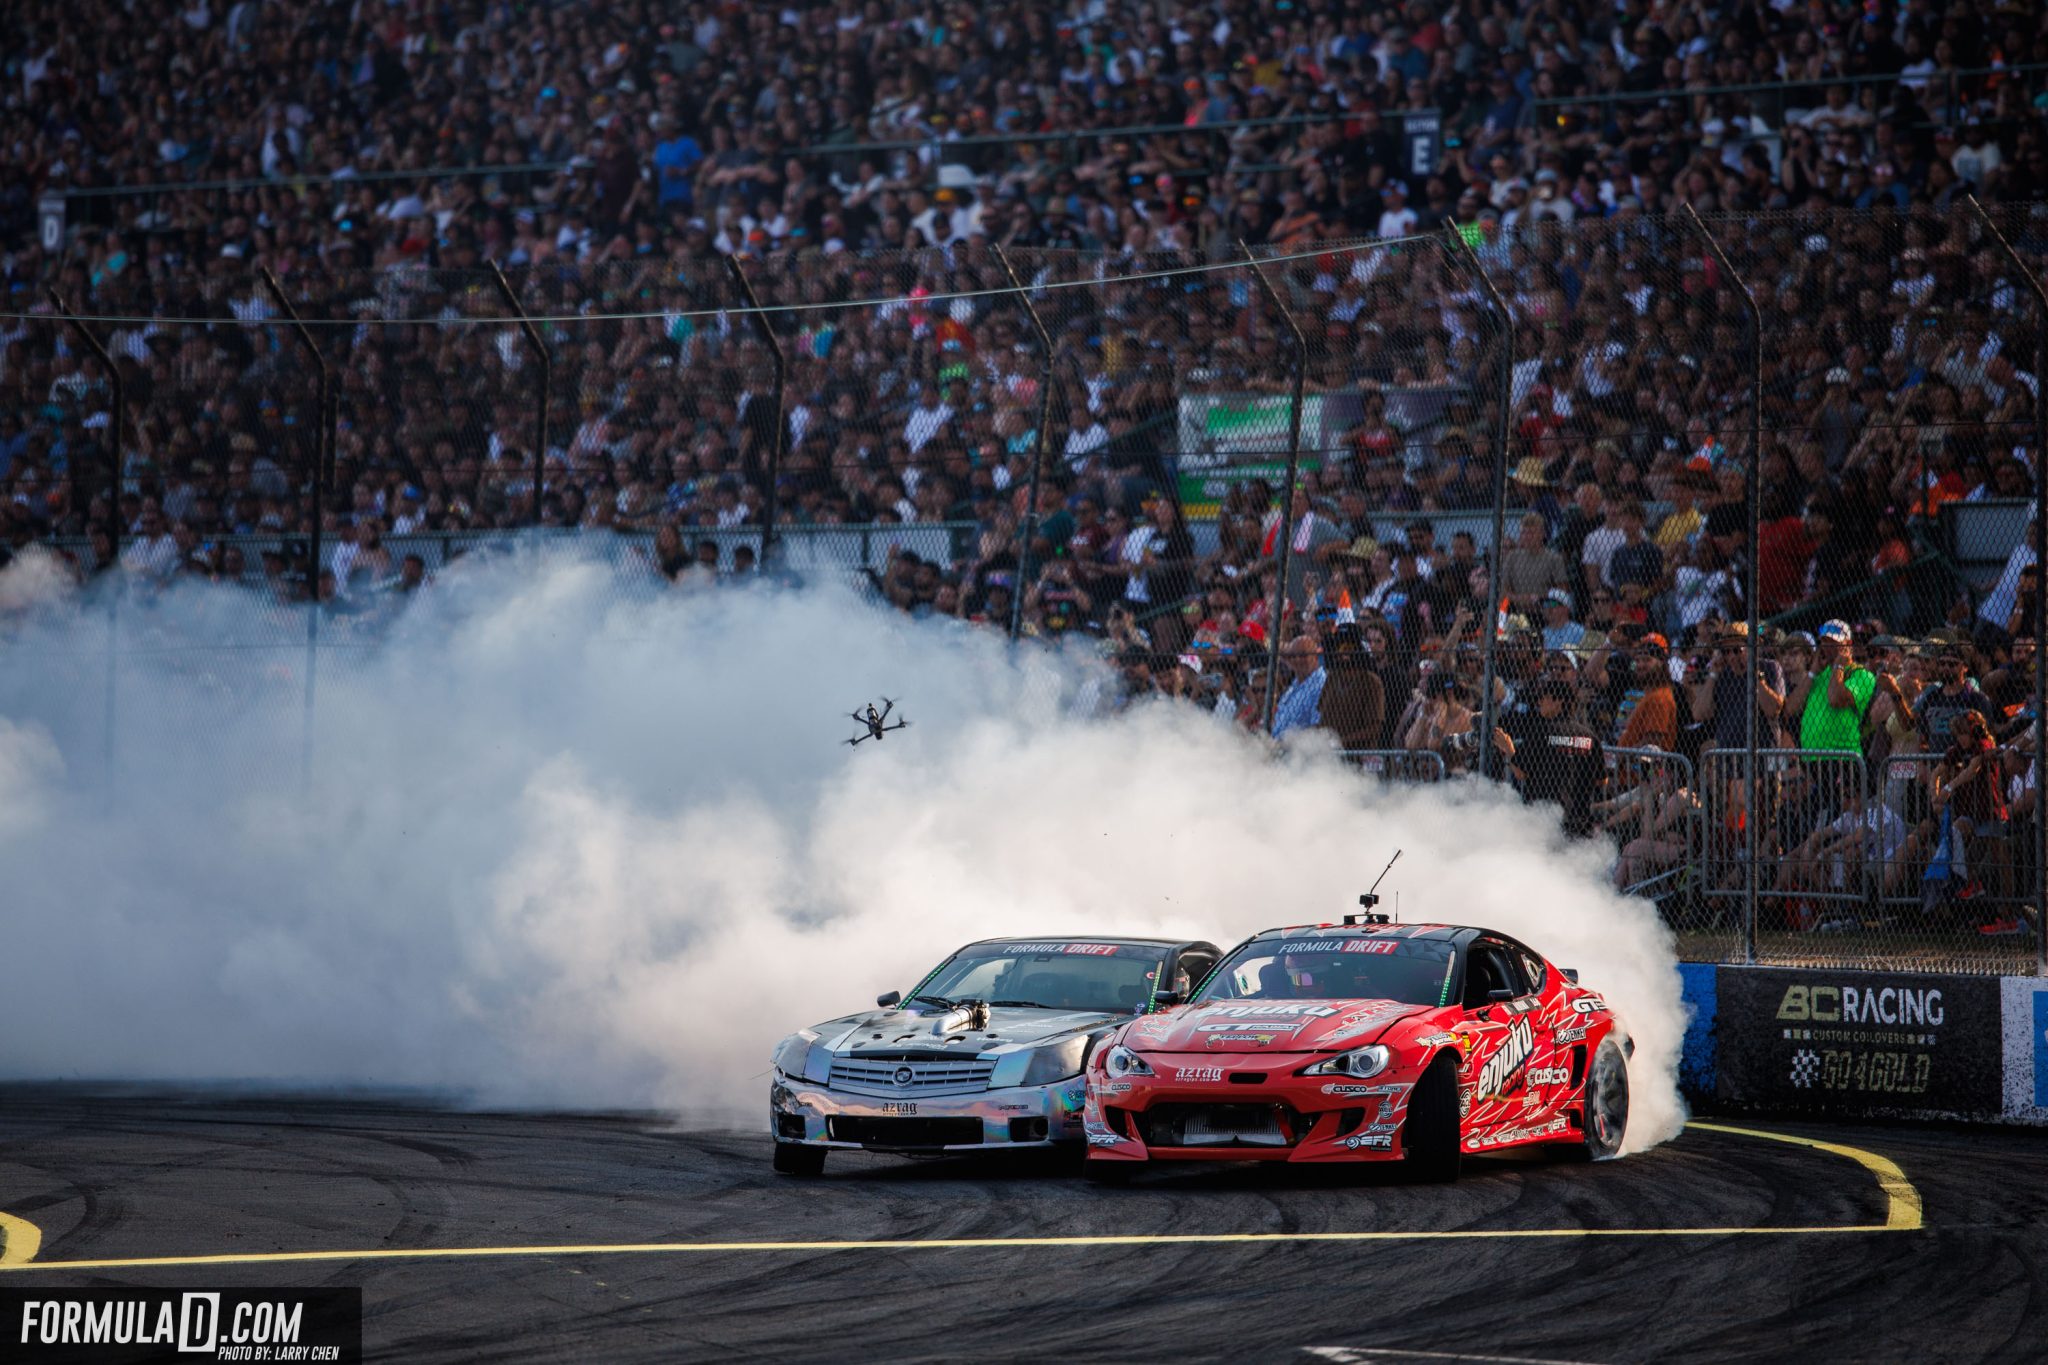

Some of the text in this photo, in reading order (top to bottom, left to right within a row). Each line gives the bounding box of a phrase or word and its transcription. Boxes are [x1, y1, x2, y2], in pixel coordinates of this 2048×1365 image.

[1411, 137, 1431, 174] E
[1003, 944, 1117, 955] FORMULA DRIFT
[1278, 940, 1398, 954] FORMULA DRIFT
[1843, 986, 1944, 1026] RACING
[1812, 1029, 1906, 1044] CUSTOM COILOVERS
[1478, 1017, 1533, 1103] enjuku
[1175, 1067, 1224, 1081] azrag
[882, 1101, 918, 1115] azrag
[1360, 1135, 1392, 1147] EFR
